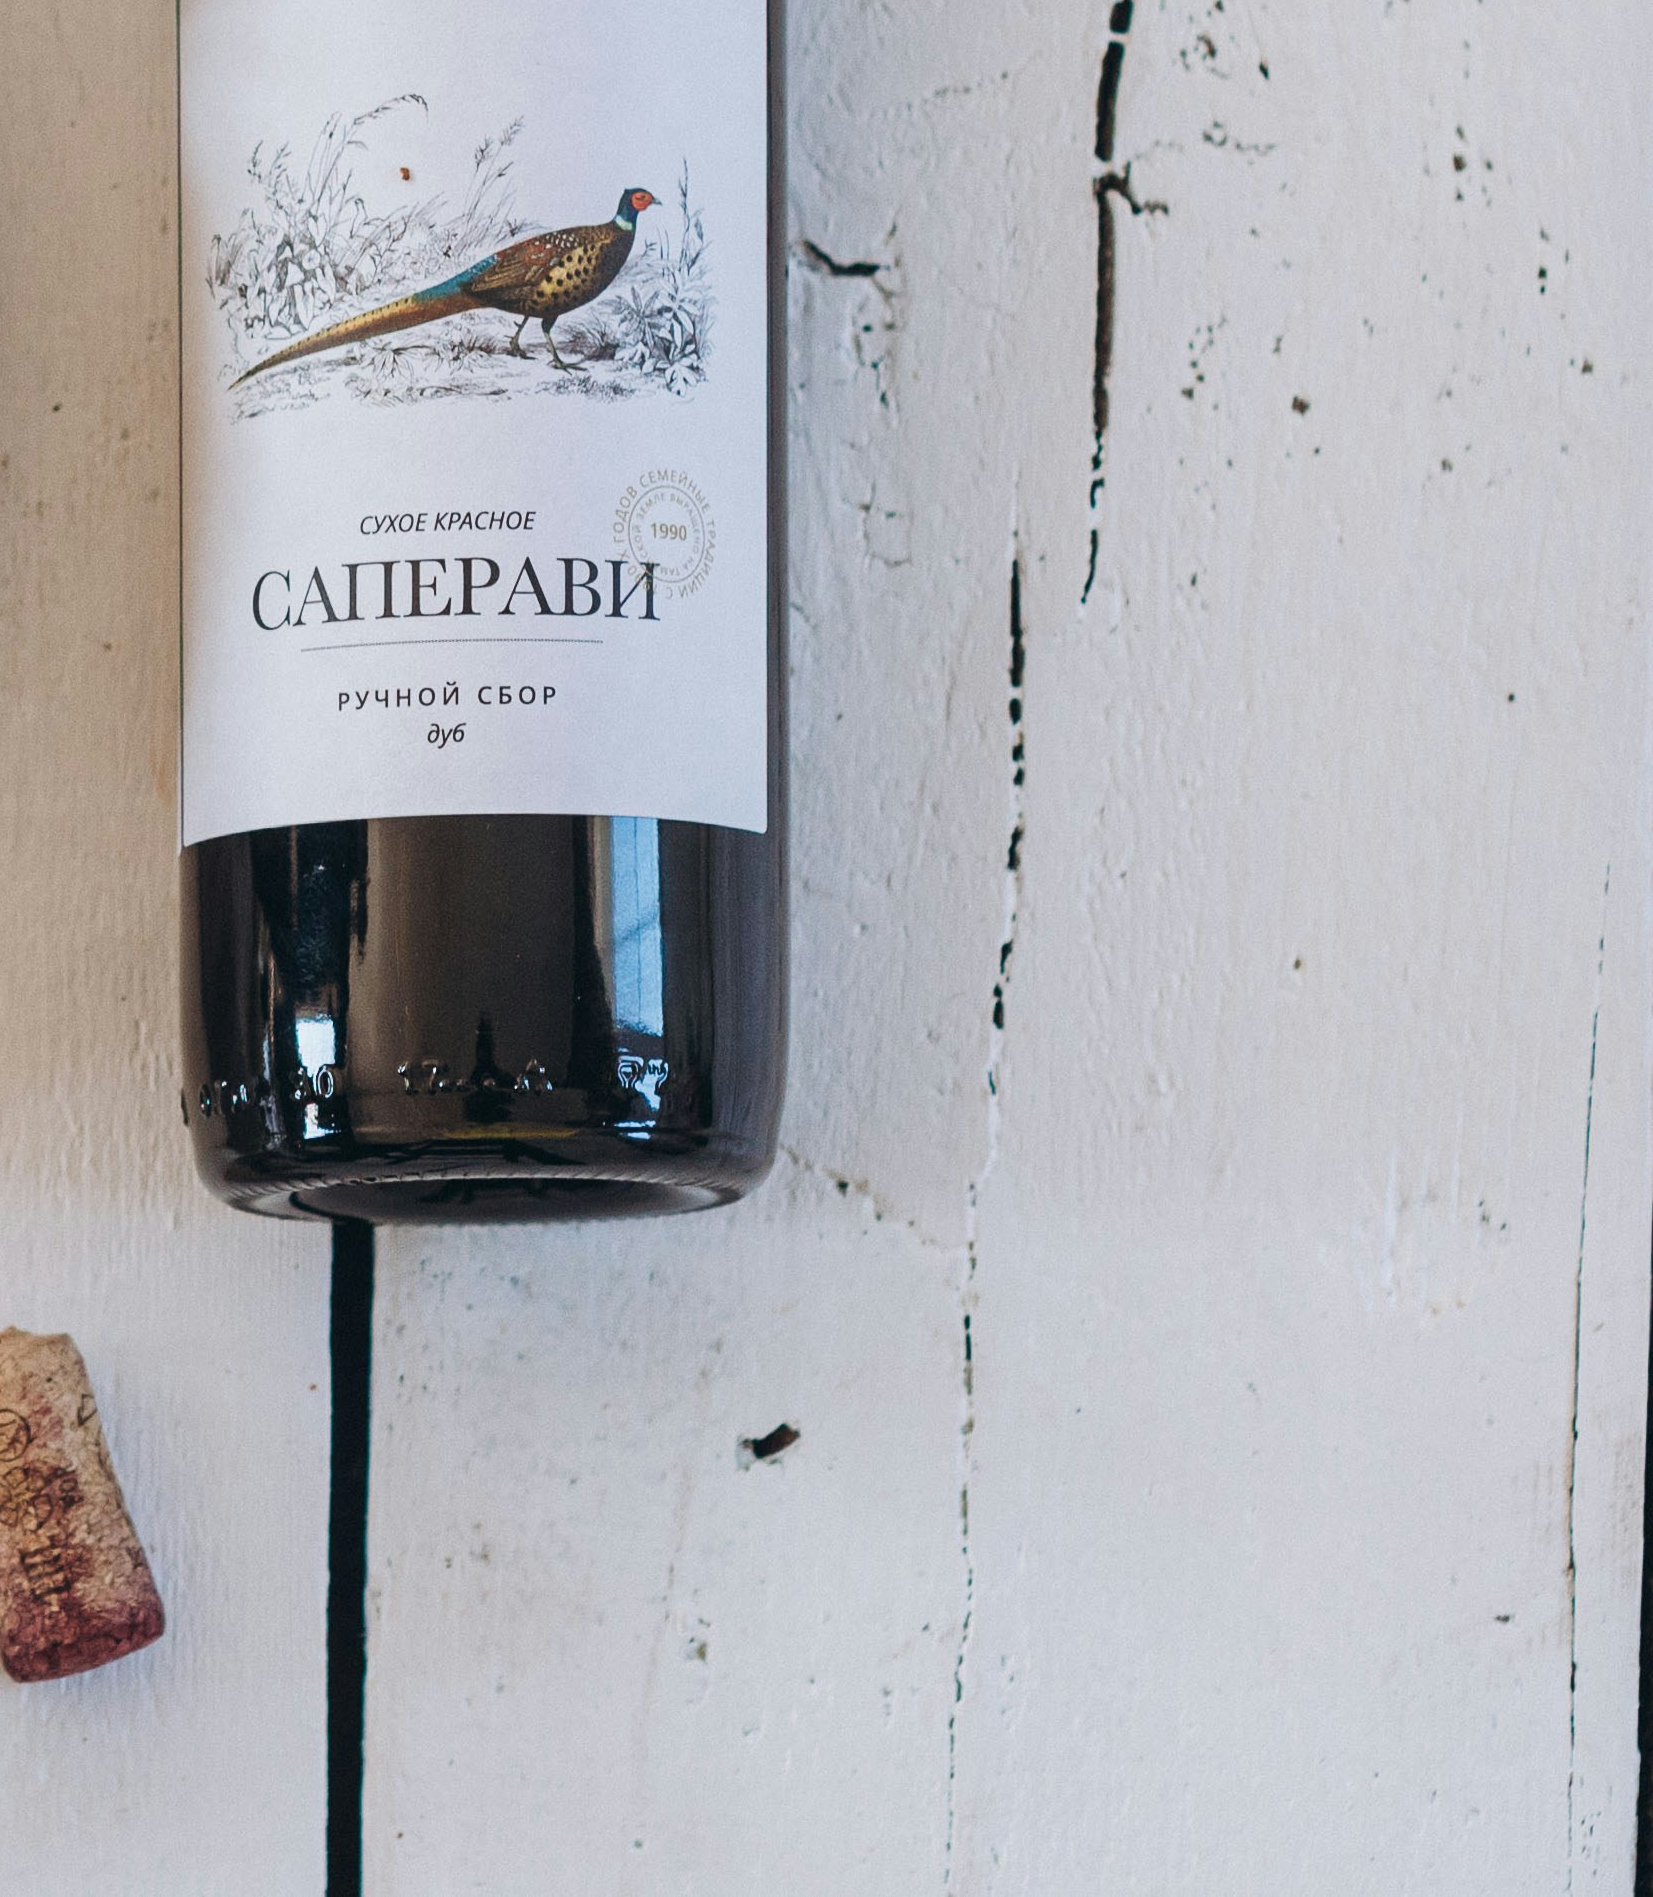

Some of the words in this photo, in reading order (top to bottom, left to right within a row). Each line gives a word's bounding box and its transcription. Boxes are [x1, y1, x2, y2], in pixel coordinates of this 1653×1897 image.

[639, 468, 711, 516] СЕМЕЙНЫЕ
[359, 512, 428, 536] СУХОЕ
[433, 510, 537, 533] КРАСНОЕ
[612, 485, 638, 544] ГОДОВ
[649, 522, 688, 542] 1990
[679, 518, 717, 599] ТРАДИЦИИ
[250, 557, 662, 631] САПЕРАВИ
[337, 681, 462, 712] РУЧНОЙ
[476, 684, 560, 707] СБОР
[426, 722, 467, 749] дуб
